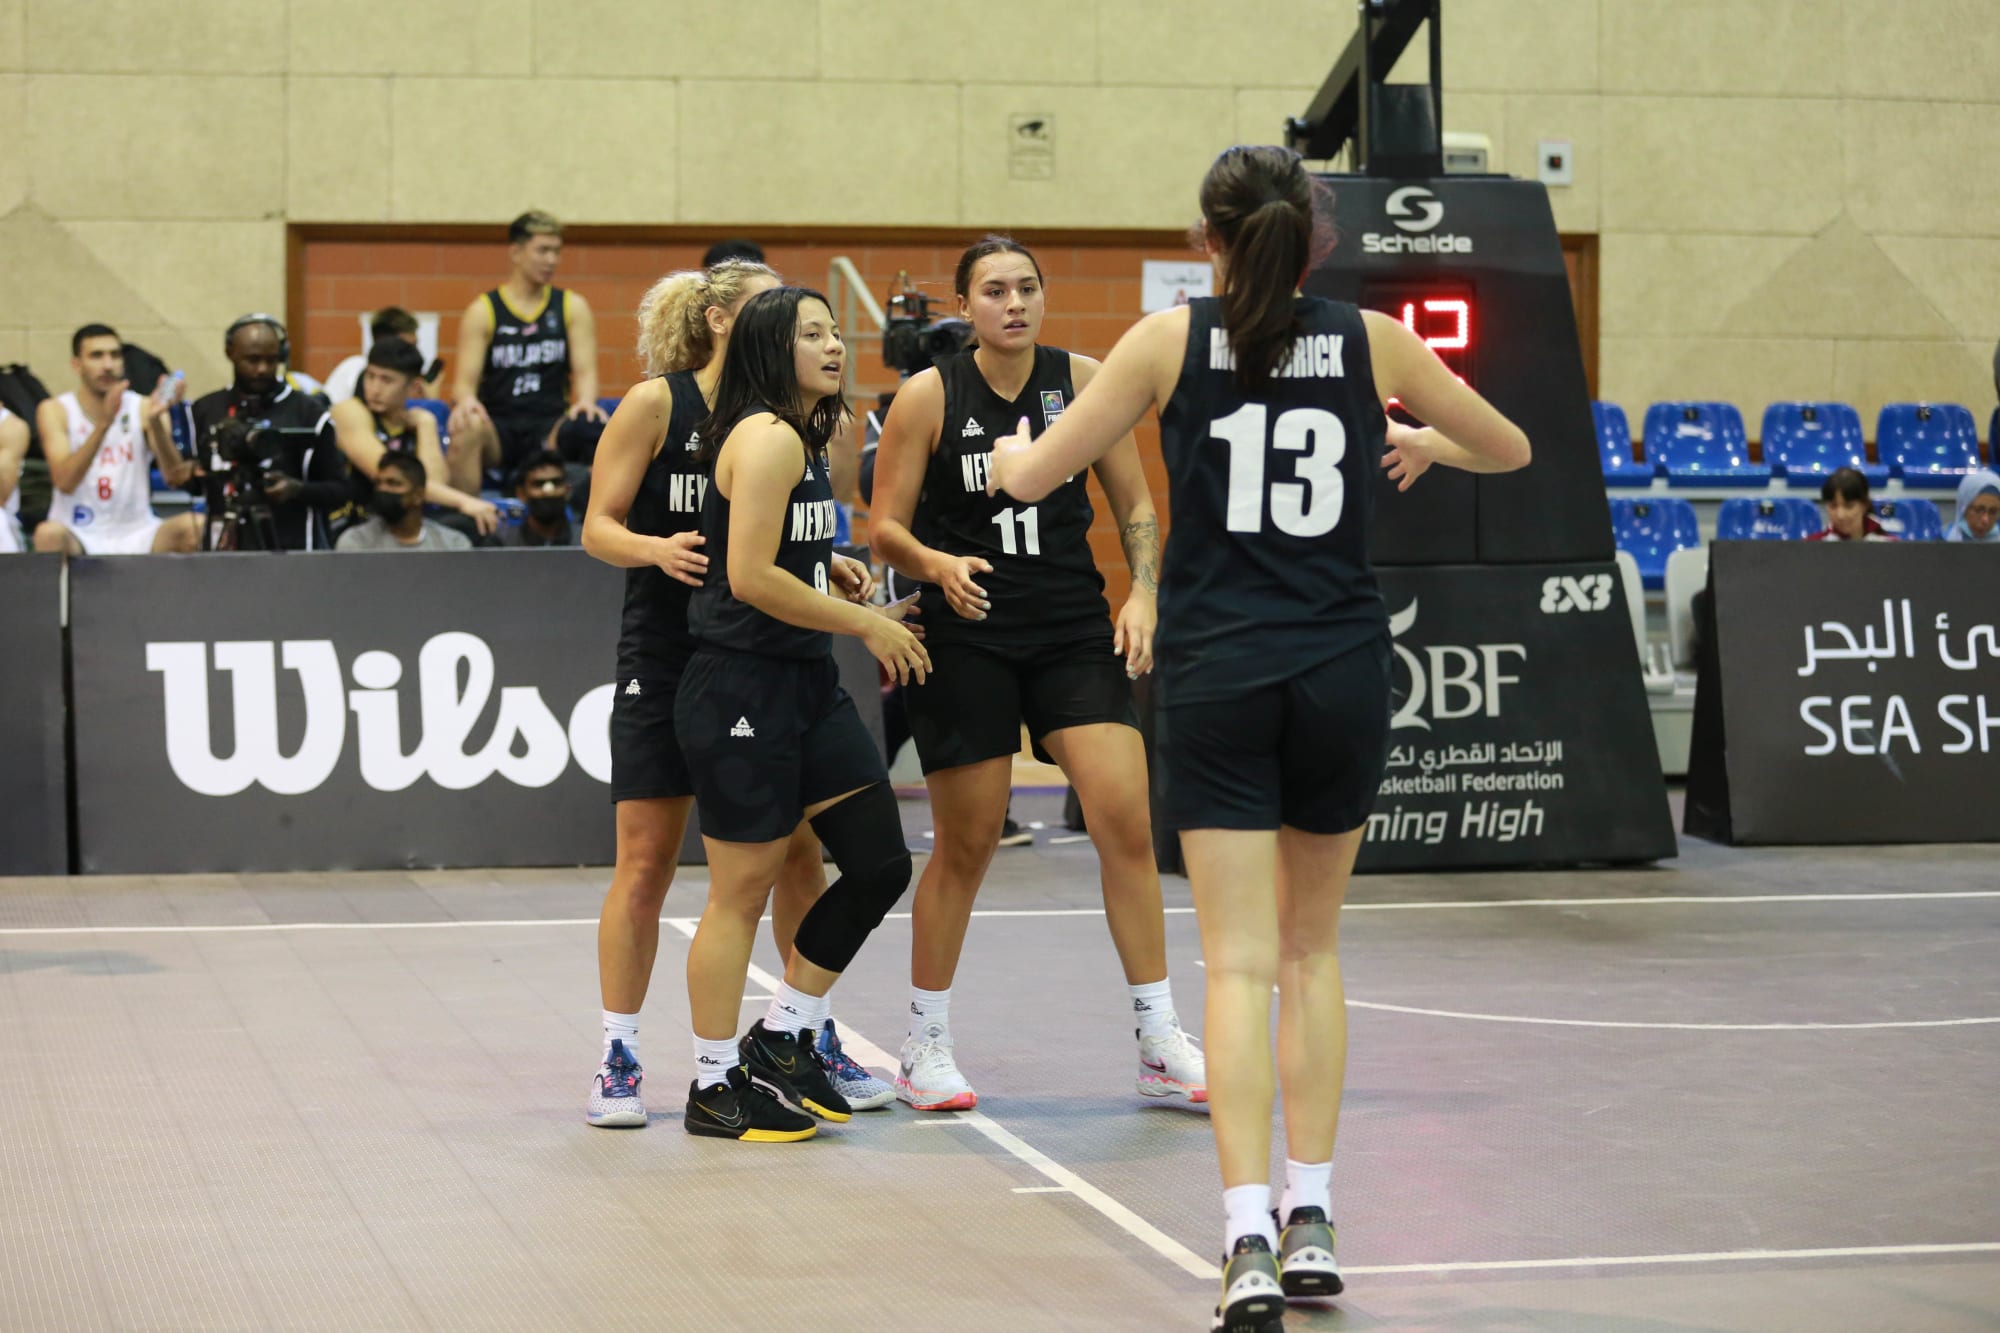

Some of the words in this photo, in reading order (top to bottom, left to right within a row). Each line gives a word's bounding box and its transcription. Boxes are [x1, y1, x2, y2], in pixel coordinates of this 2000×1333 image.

[1362, 233, 1472, 253] Schelde
[1209, 328, 1344, 378] MRICK
[962, 427, 985, 437] PEAK
[101, 443, 133, 465] AN
[1209, 402, 1346, 538] 13
[790, 501, 823, 541] NEW
[991, 506, 1040, 555] 11
[1798, 599, 1914, 676] البحر
[730, 727, 755, 737] PEAK
[1800, 694, 1921, 755] SEA
[1385, 746, 1415, 769] لك
[1419, 743, 1495, 775] القطري
[1378, 774, 1456, 794] sketball
[1462, 770, 1564, 791] Federation
[1366, 806, 1448, 844] ming
[1460, 799, 1544, 841] High
